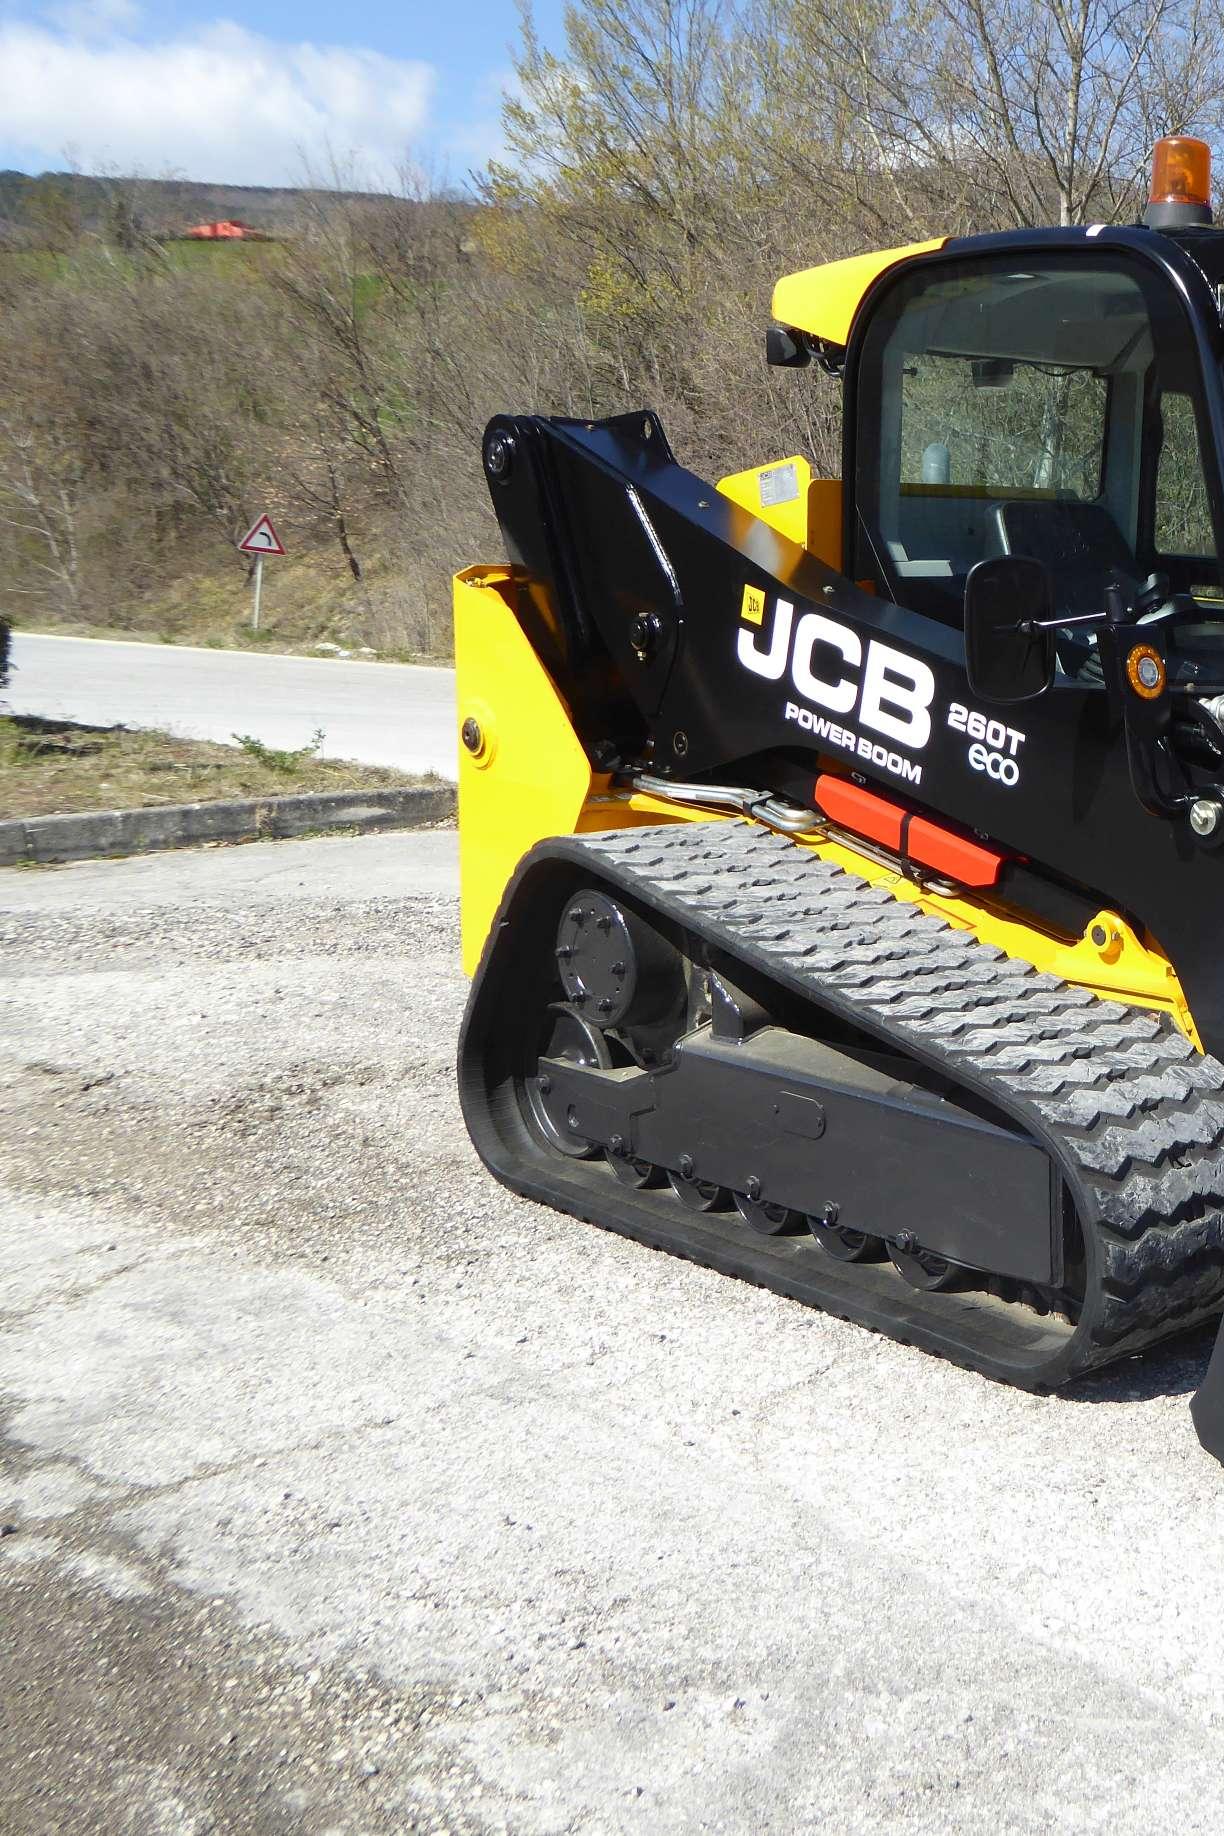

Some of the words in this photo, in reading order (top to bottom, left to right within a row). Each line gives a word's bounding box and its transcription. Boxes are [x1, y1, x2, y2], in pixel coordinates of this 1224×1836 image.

[737, 598, 936, 749] JCB
[785, 701, 857, 752] POWER
[857, 736, 923, 785] BOOM
[947, 702, 1026, 756] 260T
[968, 743, 1020, 786] eco
